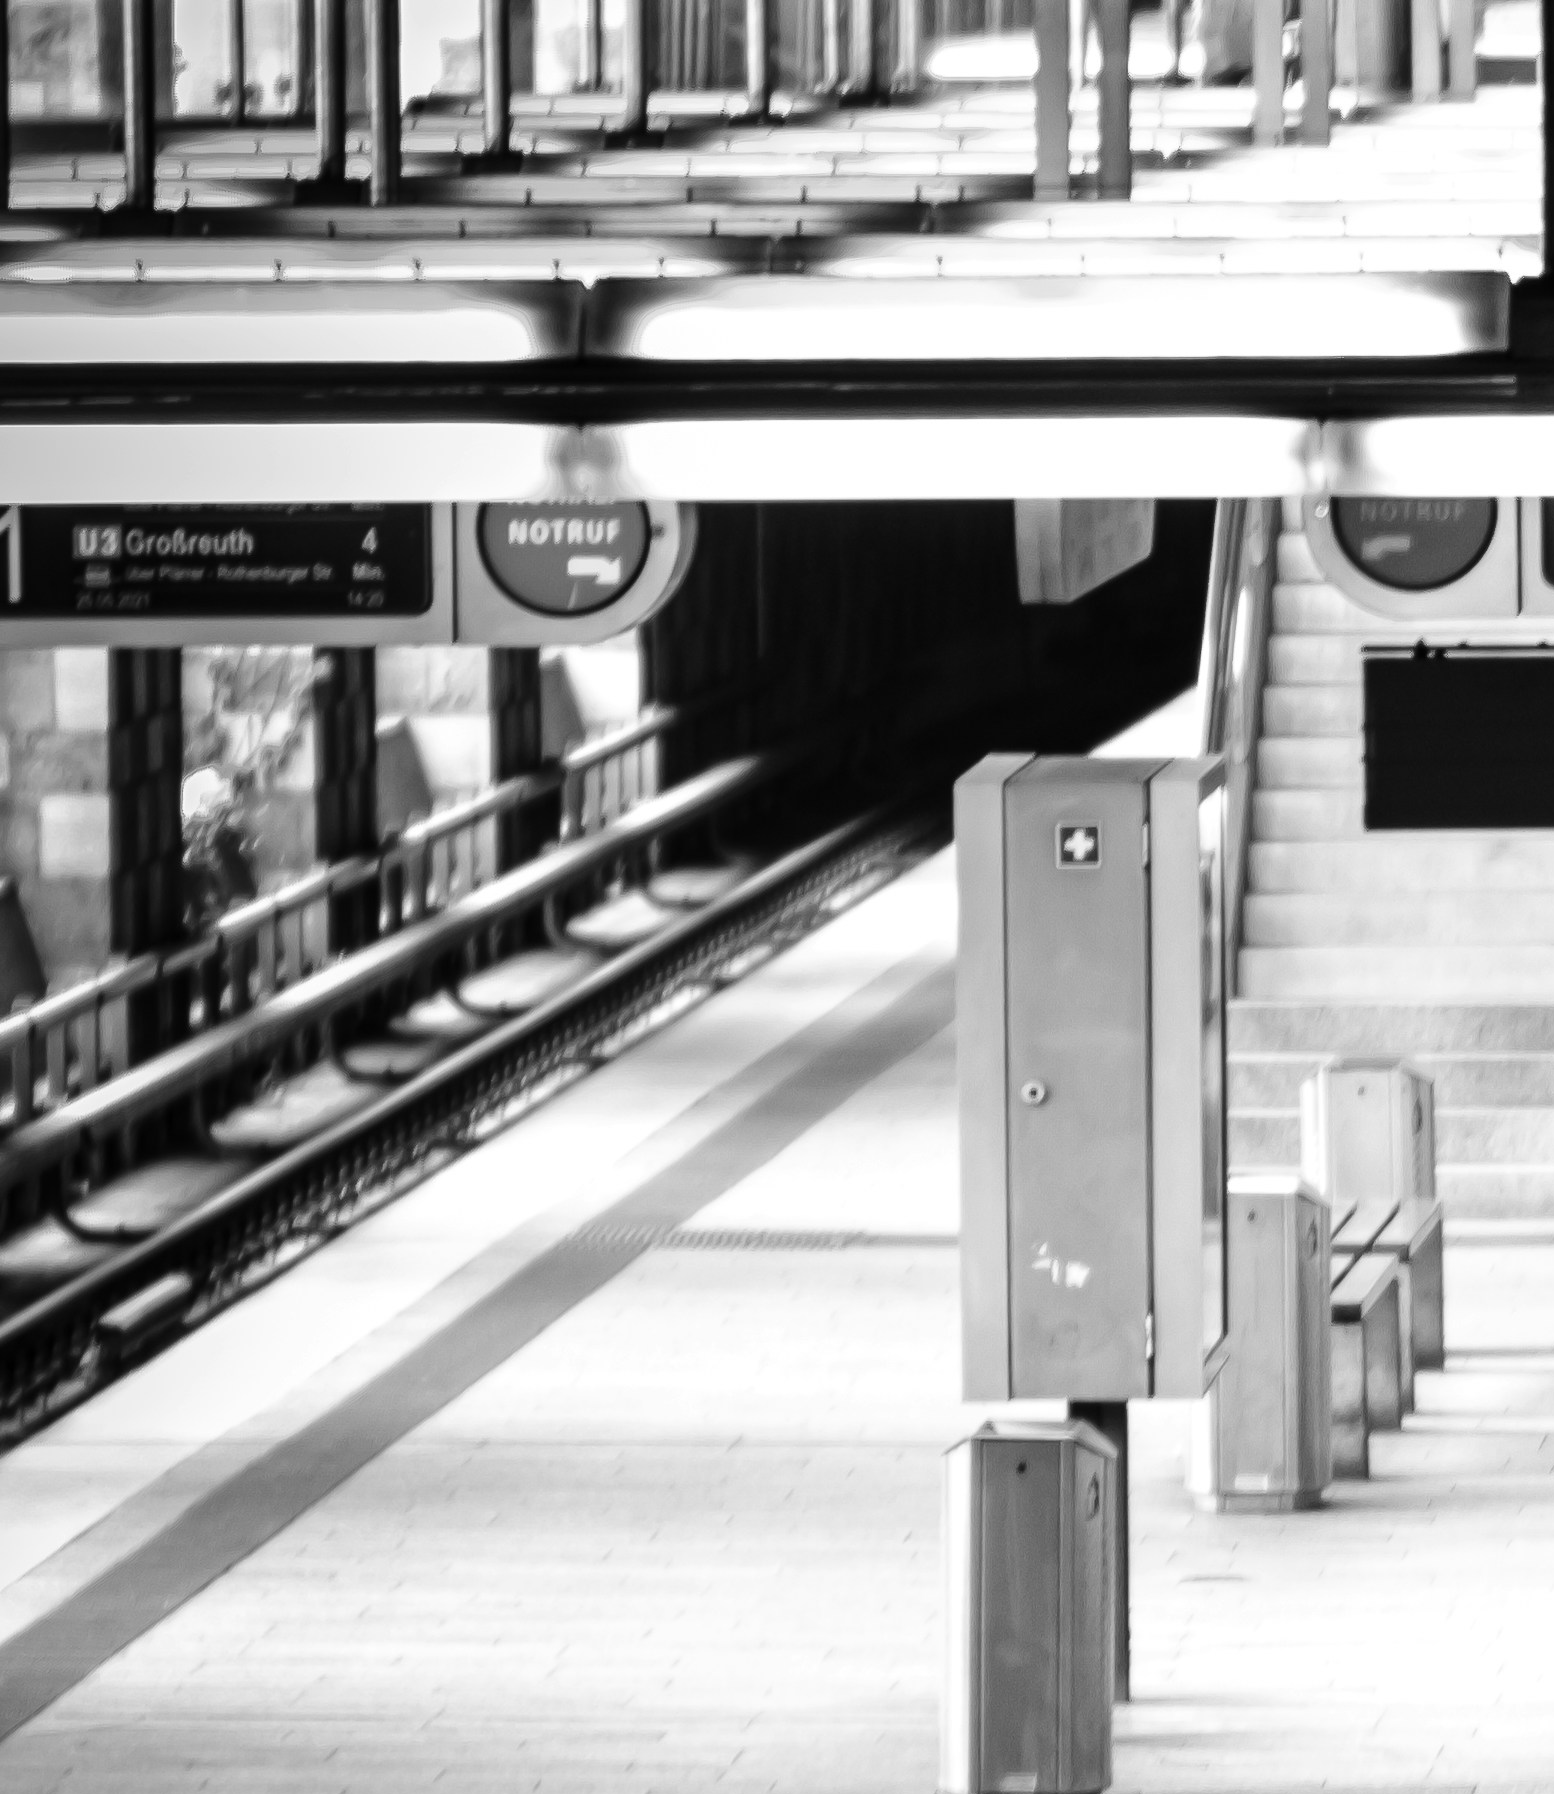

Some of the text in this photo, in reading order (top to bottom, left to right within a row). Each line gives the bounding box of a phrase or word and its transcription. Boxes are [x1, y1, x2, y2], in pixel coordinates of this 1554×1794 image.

[79, 526, 379, 557] U3 Großreuth 4
[508, 518, 621, 545] NOTRUF
